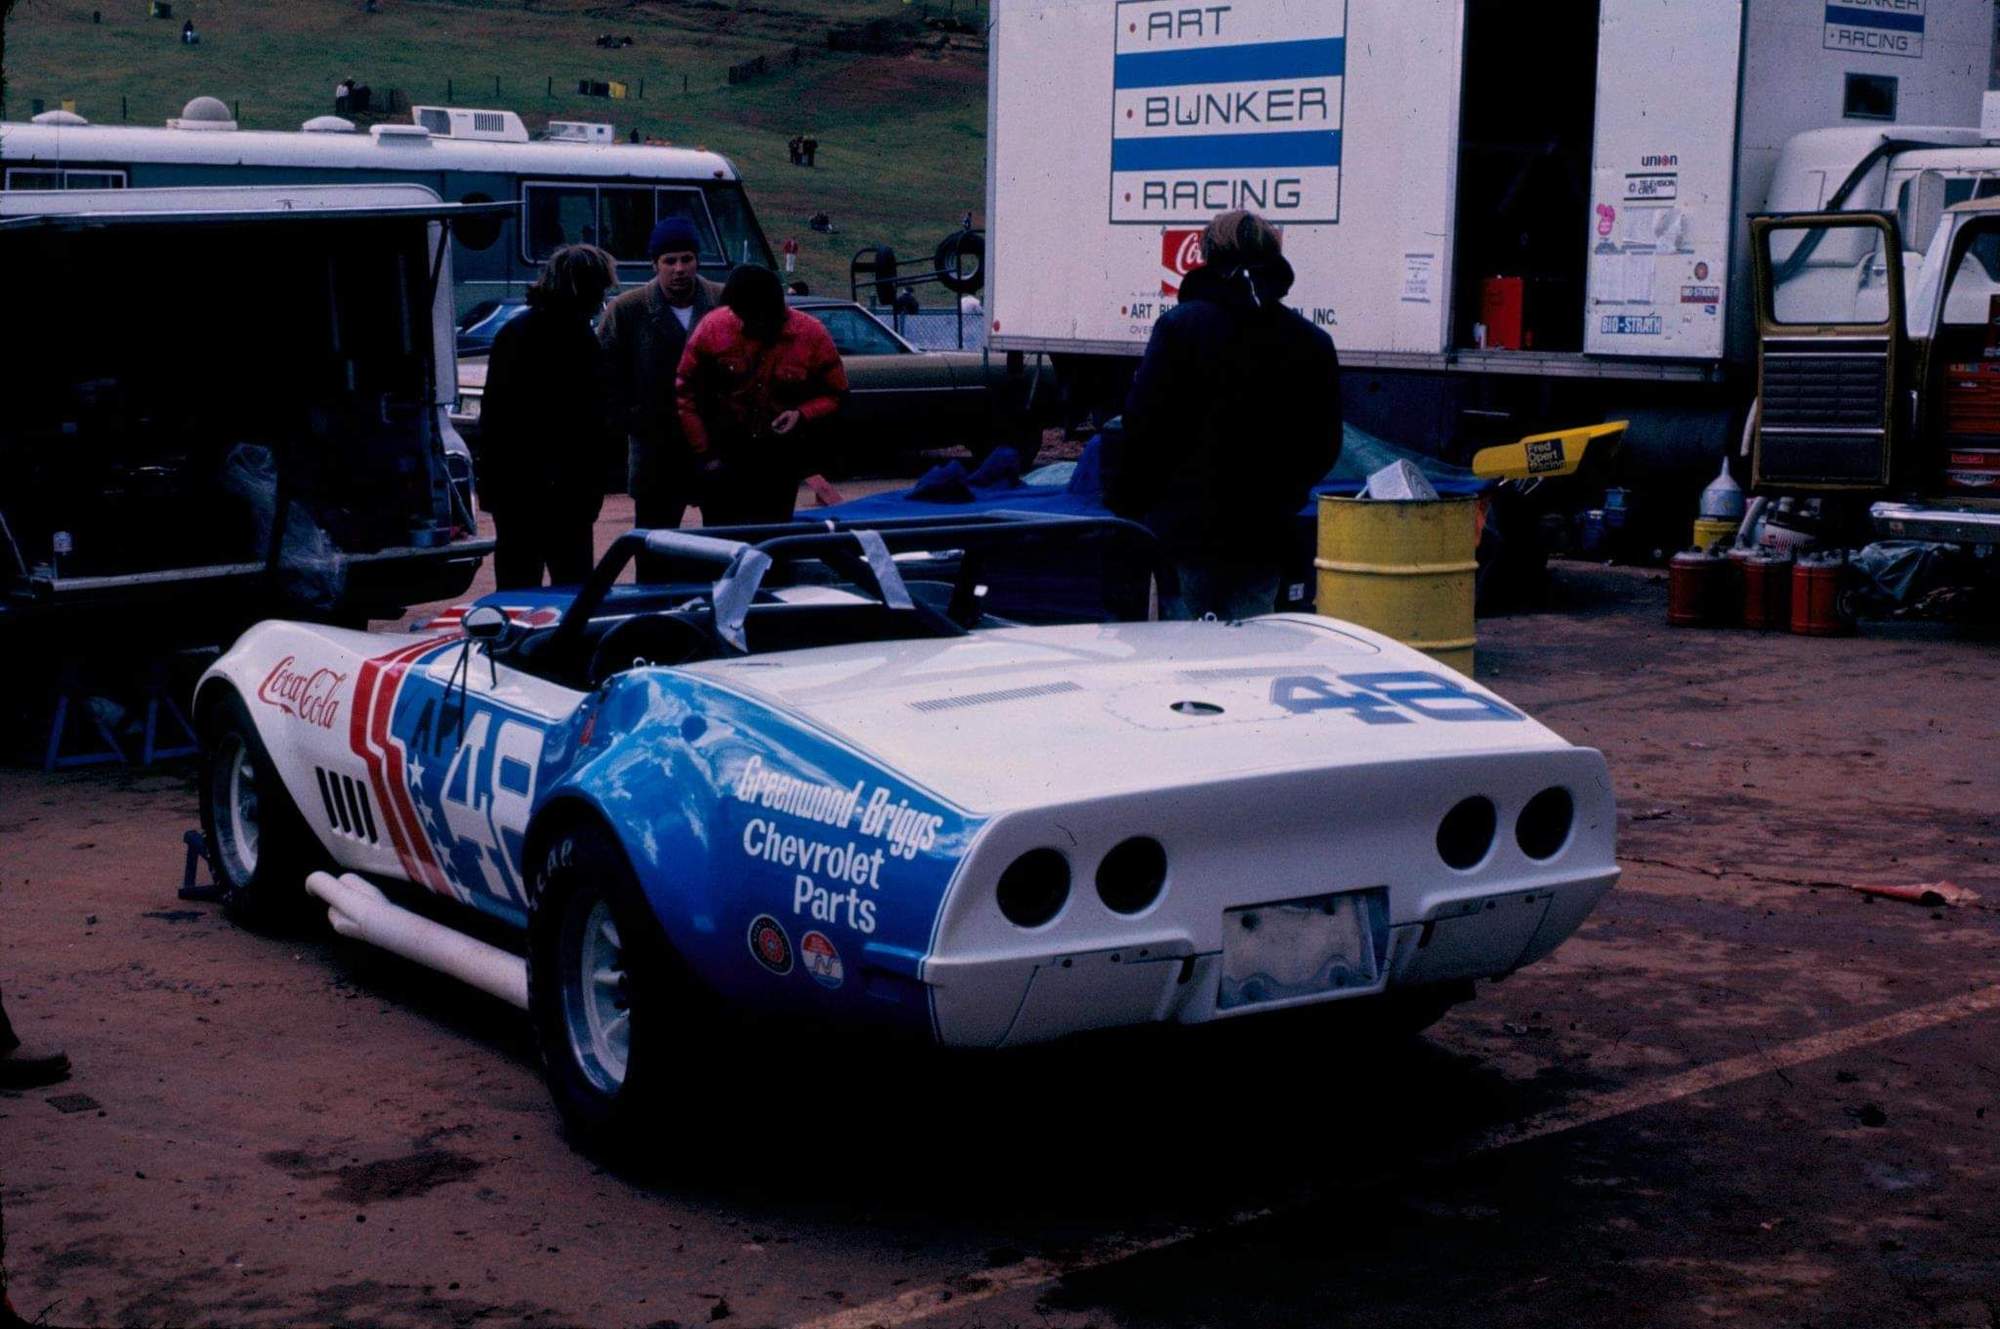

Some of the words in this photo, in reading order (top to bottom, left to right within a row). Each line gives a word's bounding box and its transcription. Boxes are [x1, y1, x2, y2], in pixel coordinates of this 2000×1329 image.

[1147, 6, 1232, 41] ART
[1838, 29, 1908, 50] RACING
[1145, 87, 1328, 127] BUNKER
[1143, 178, 1301, 210] RACING
[1130, 303, 1153, 319] ART
[1313, 308, 1338, 325] INC.
[1601, 316, 1662, 334] BIO-STRATH
[258, 656, 346, 729] Coca-Cola
[1269, 671, 1528, 725] 48
[440, 709, 546, 908] 48
[737, 755, 943, 860] Greenwood-Briggs
[743, 818, 885, 890] Chevrolet
[793, 875, 877, 934] Parts
